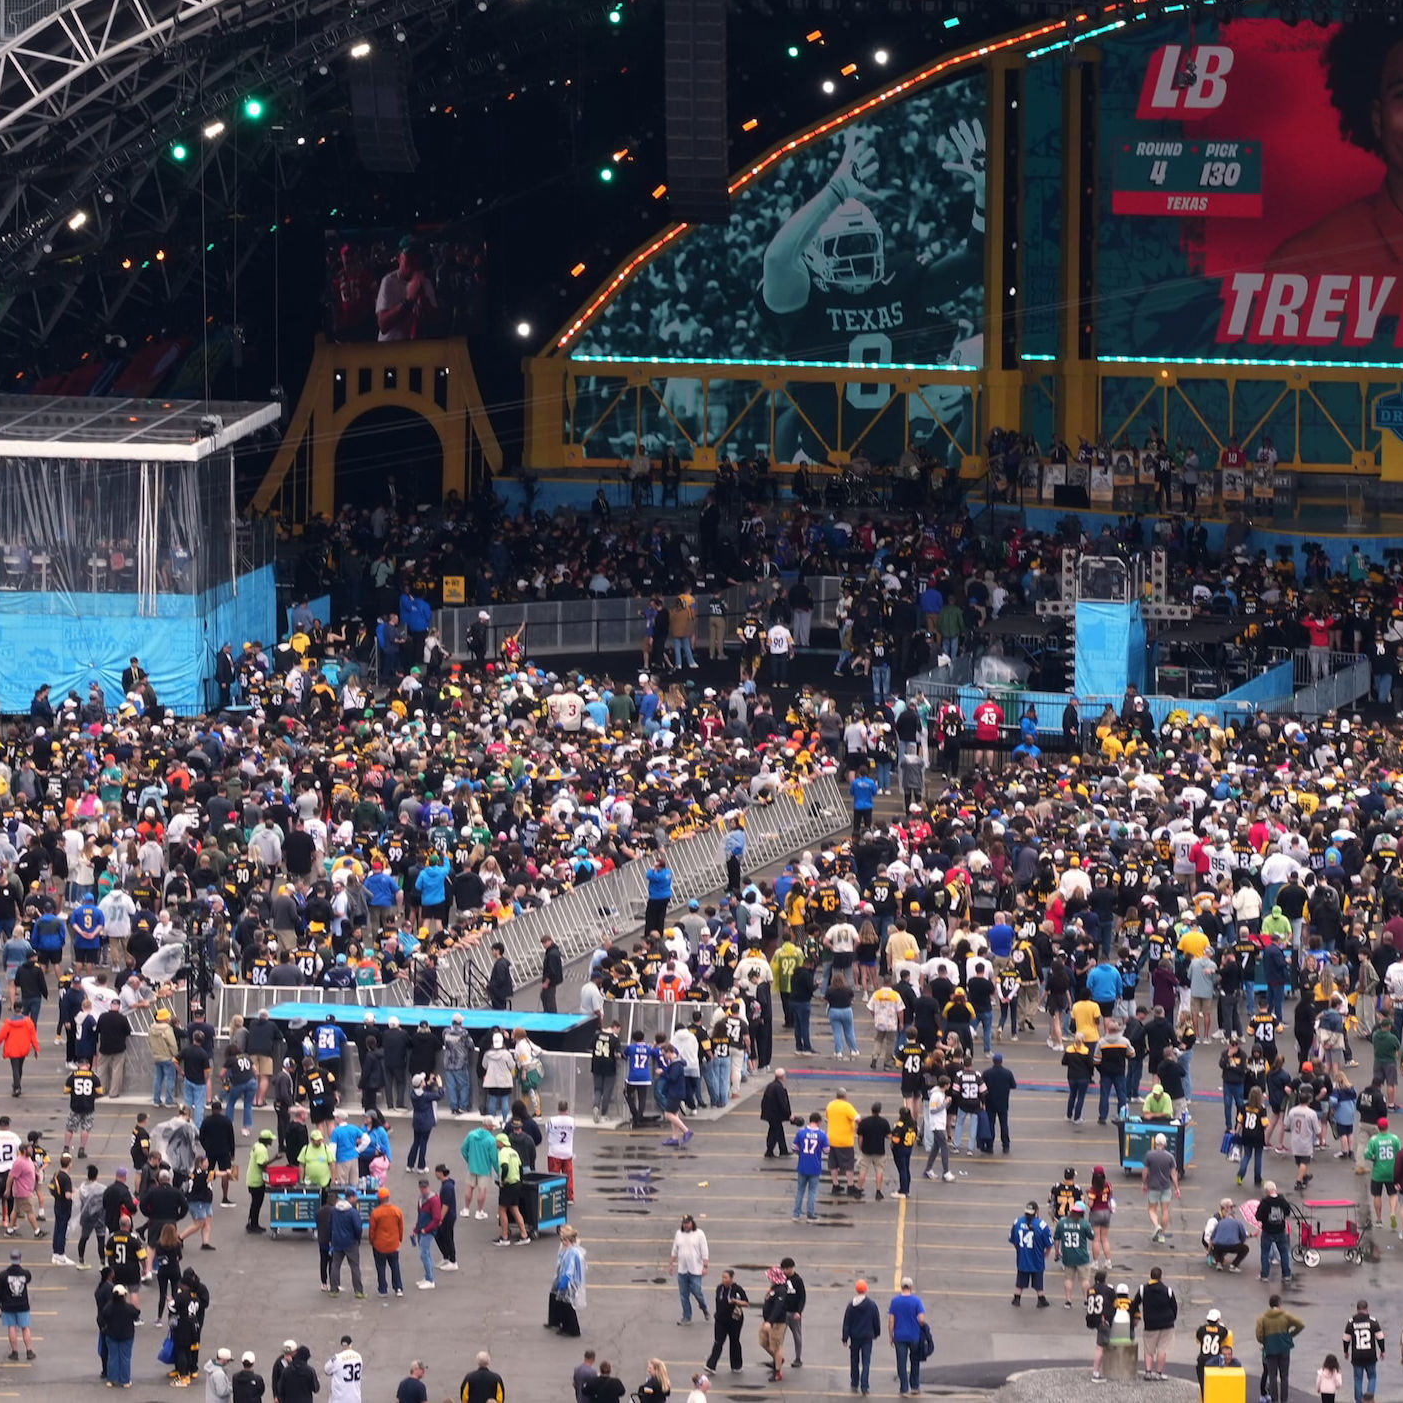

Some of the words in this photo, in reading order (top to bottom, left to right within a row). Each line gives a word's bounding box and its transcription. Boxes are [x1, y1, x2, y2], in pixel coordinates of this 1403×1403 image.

[1151, 45, 1235, 109] LB
[1136, 142, 1183, 157] ROUND
[1205, 144, 1239, 158] PICK
[1150, 161, 1168, 186] 4
[1199, 162, 1242, 187] 130
[1166, 196, 1208, 211] TEXAS
[1227, 272, 1396, 339] TREY
[826, 301, 904, 331] TEXAS
[1257, 1024, 1274, 1040] 43
[905, 1055, 921, 1071] 43
[75, 1079, 92, 1095] 58
[963, 1082, 978, 1097] 32
[804, 1139, 818, 1153] 17
[1379, 1146, 1393, 1160] 26
[1019, 1230, 1034, 1248] 14
[1065, 1231, 1080, 1248] 33
[1087, 1296, 1103, 1314] 83
[1203, 1335, 1219, 1355] 86
[1355, 1331, 1371, 1349] 12
[343, 1363, 360, 1381] 32
